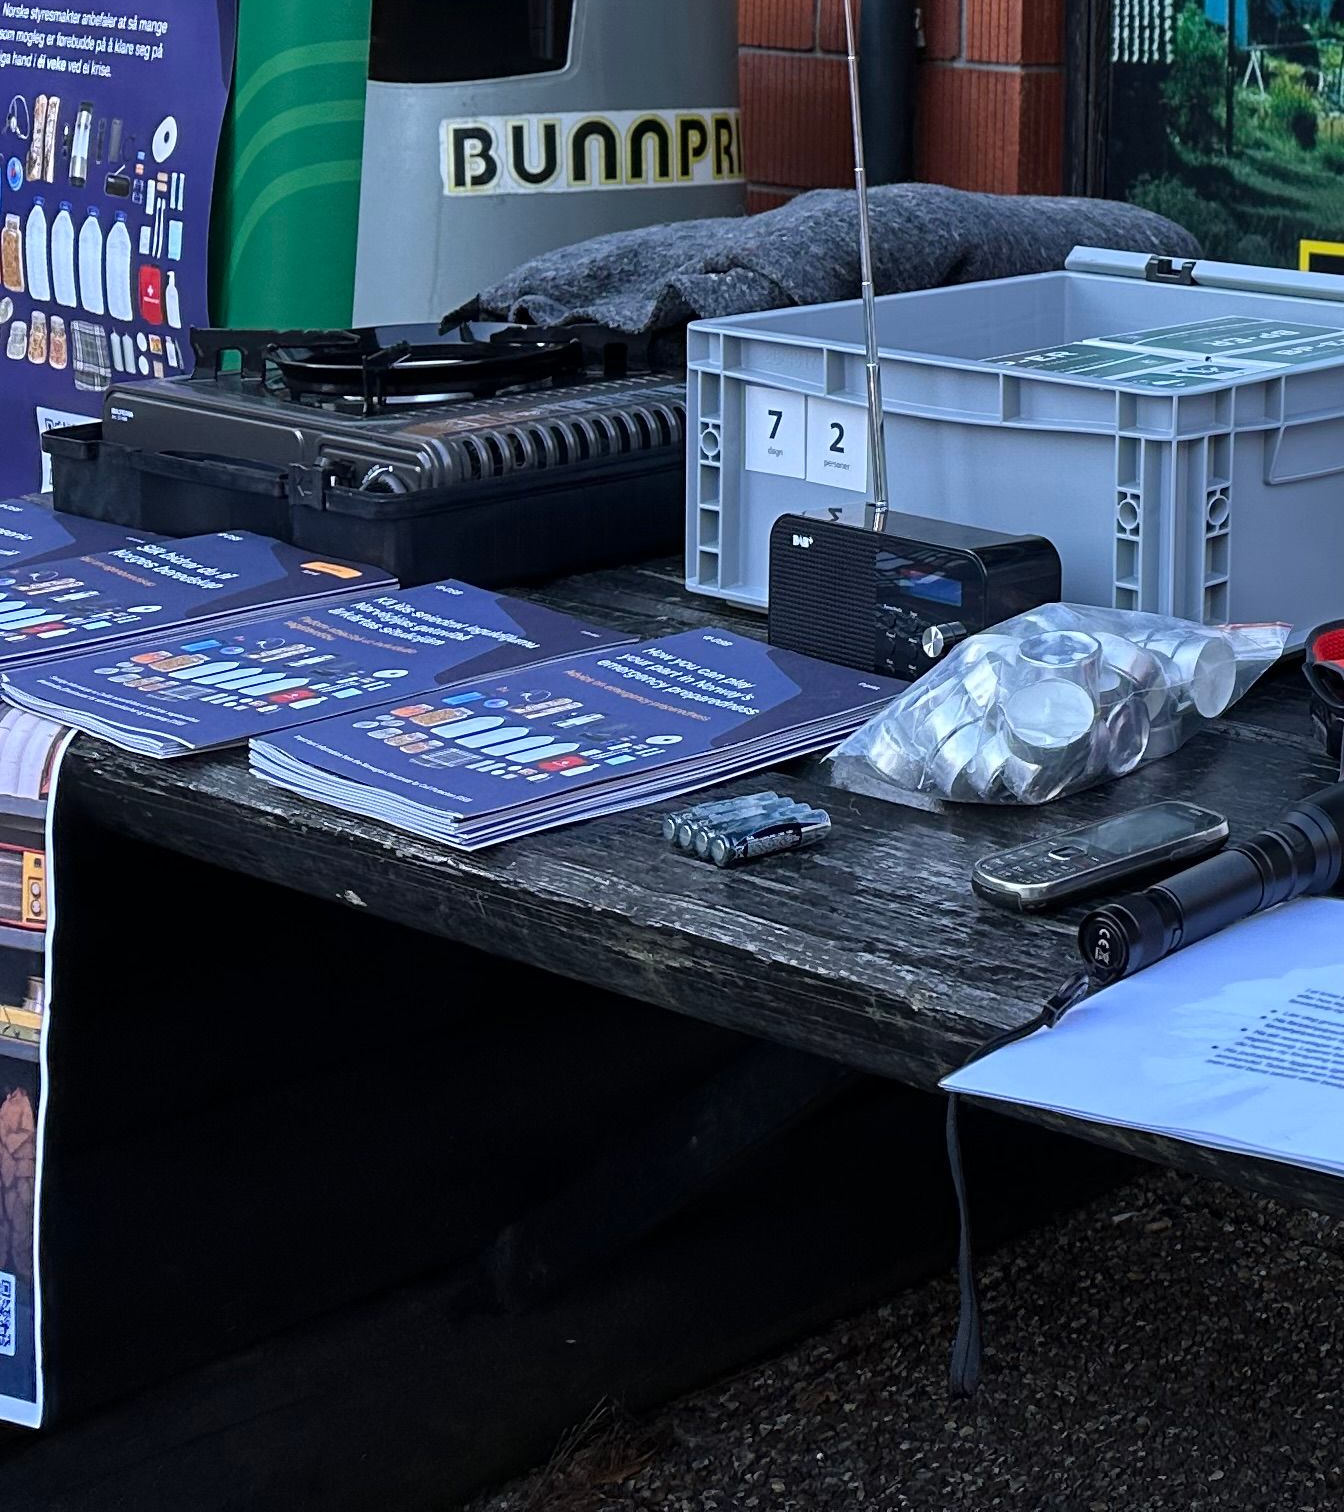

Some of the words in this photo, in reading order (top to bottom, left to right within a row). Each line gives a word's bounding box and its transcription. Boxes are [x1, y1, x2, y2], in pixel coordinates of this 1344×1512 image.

[2, 2, 30, 19] Norske
[30, 6, 81, 24] styresmakter
[82, 10, 118, 28] anbefaler
[117, 16, 127, 30] at
[127, 14, 138, 31] så
[138, 19, 168, 36] mange
[16, 29, 45, 48] mogleg
[46, 34, 56, 45] er
[95, 37, 107, 53] på
[114, 40, 135, 56] klare
[135, 43, 151, 61] seg
[151, 42, 164, 61] på
[12, 51, 32, 68] hand
[68, 58, 83, 75] ved
[91, 59, 112, 78] krise.
[767, 409, 783, 439] 7
[829, 422, 846, 454] 2
[767, 445, 784, 457] døgn
[823, 458, 850, 471] personer
[711, 637, 734, 648] DSB
[615, 653, 646, 671] your
[648, 662, 677, 678] part
[676, 671, 694, 684] in
[694, 678, 755, 702] Norway's
[641, 647, 672, 662] How
[673, 657, 701, 672] you
[700, 666, 724, 679] can
[725, 674, 757, 691] play
[597, 659, 668, 691] emergency
[664, 685, 760, 717] preparedness
